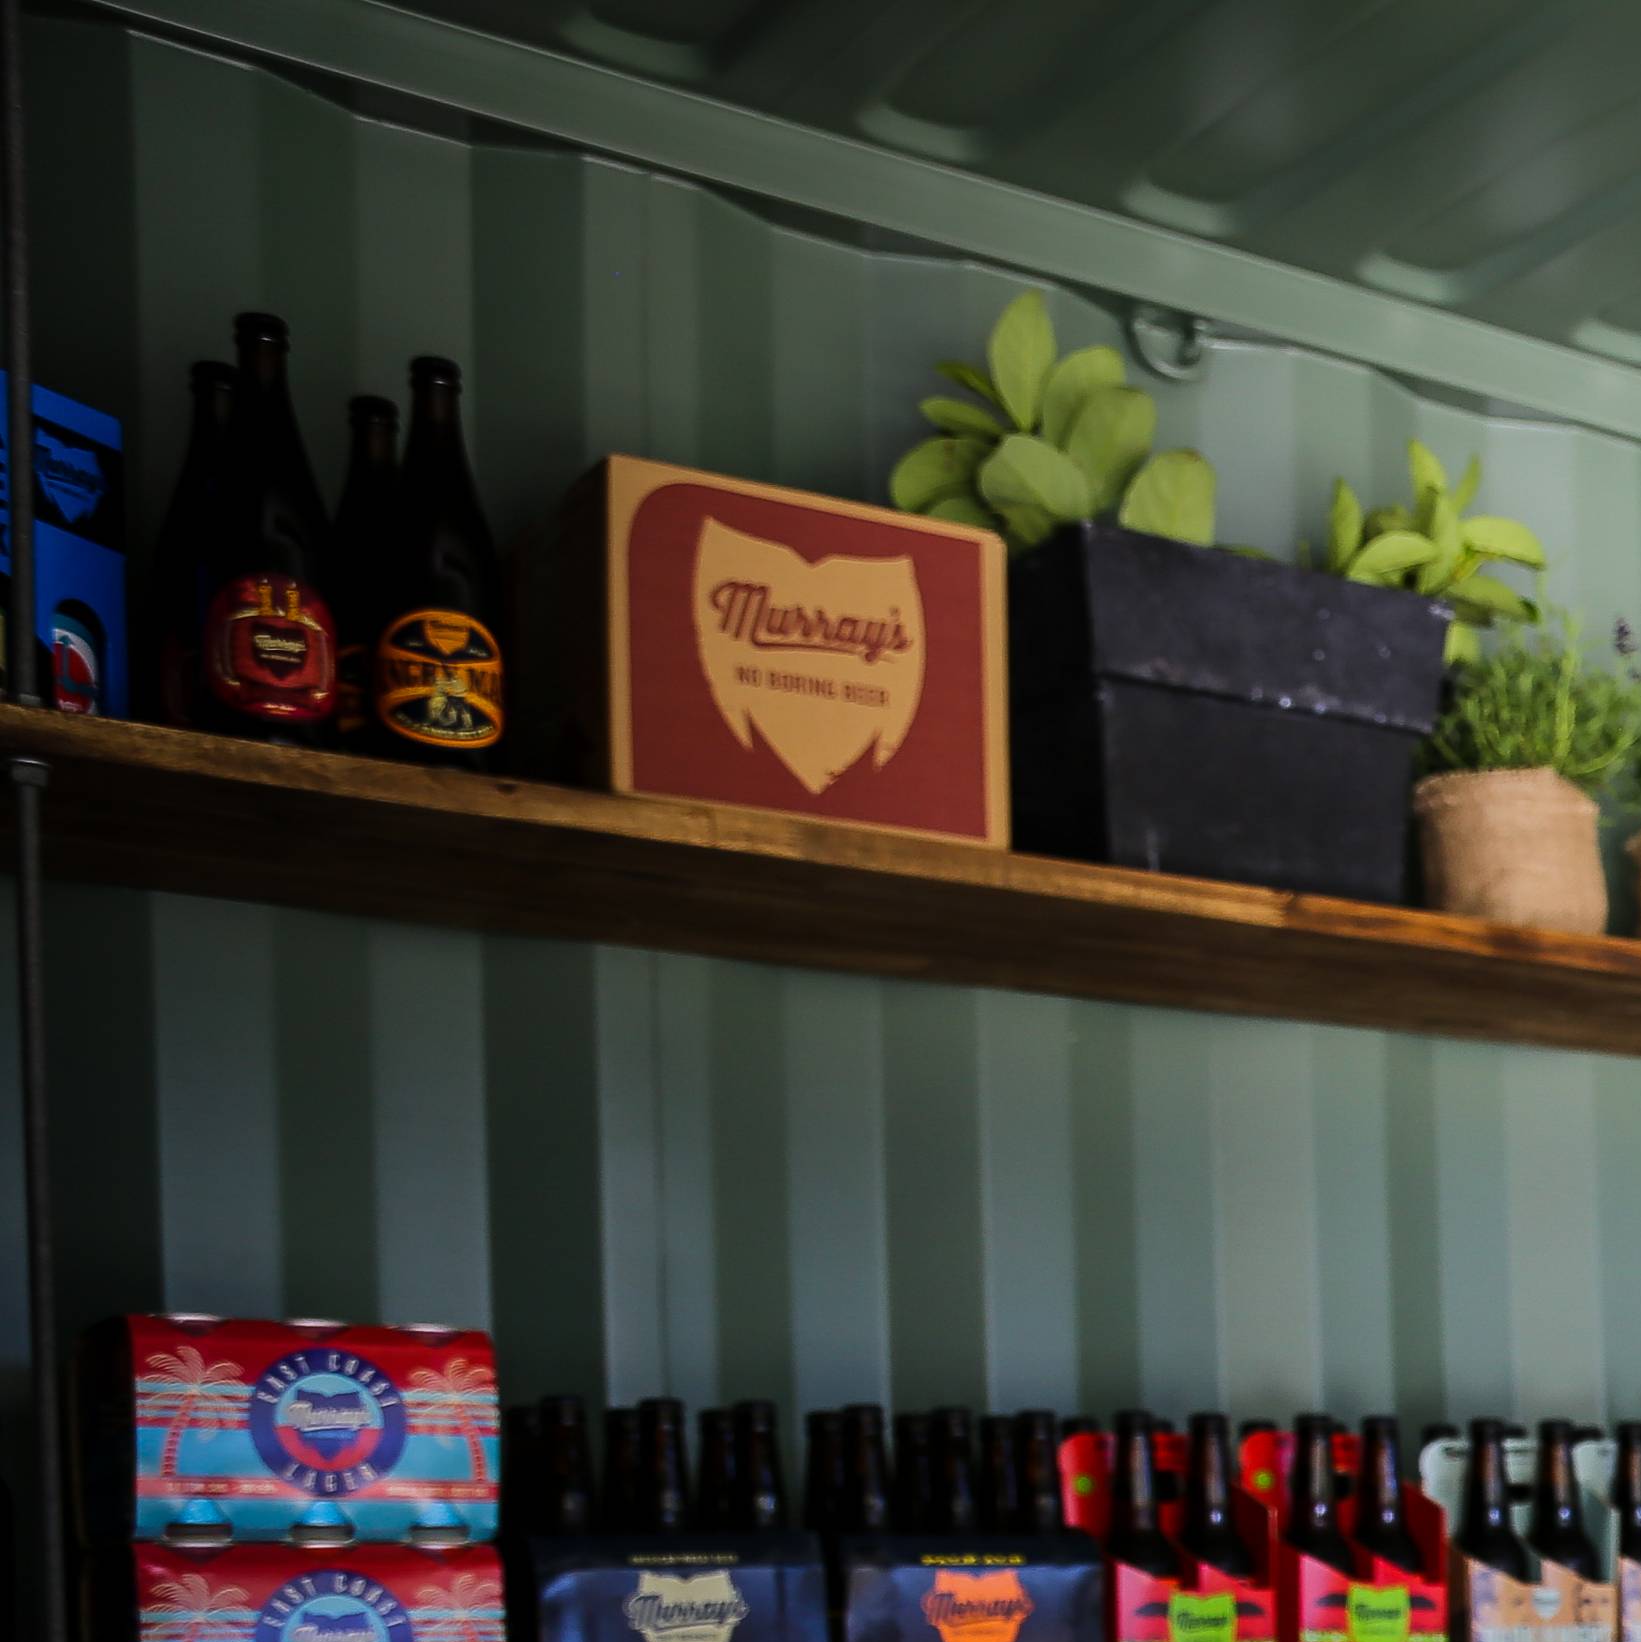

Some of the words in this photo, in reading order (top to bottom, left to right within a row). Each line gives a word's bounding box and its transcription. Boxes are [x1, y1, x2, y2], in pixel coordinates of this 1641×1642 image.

[710, 580, 912, 665] Murray's
[256, 1353, 311, 1404] EAST
[328, 1353, 400, 1407] COAST
[284, 1462, 378, 1493] LAGER
[263, 1576, 316, 1628] EAST
[334, 1573, 406, 1628] COAST
